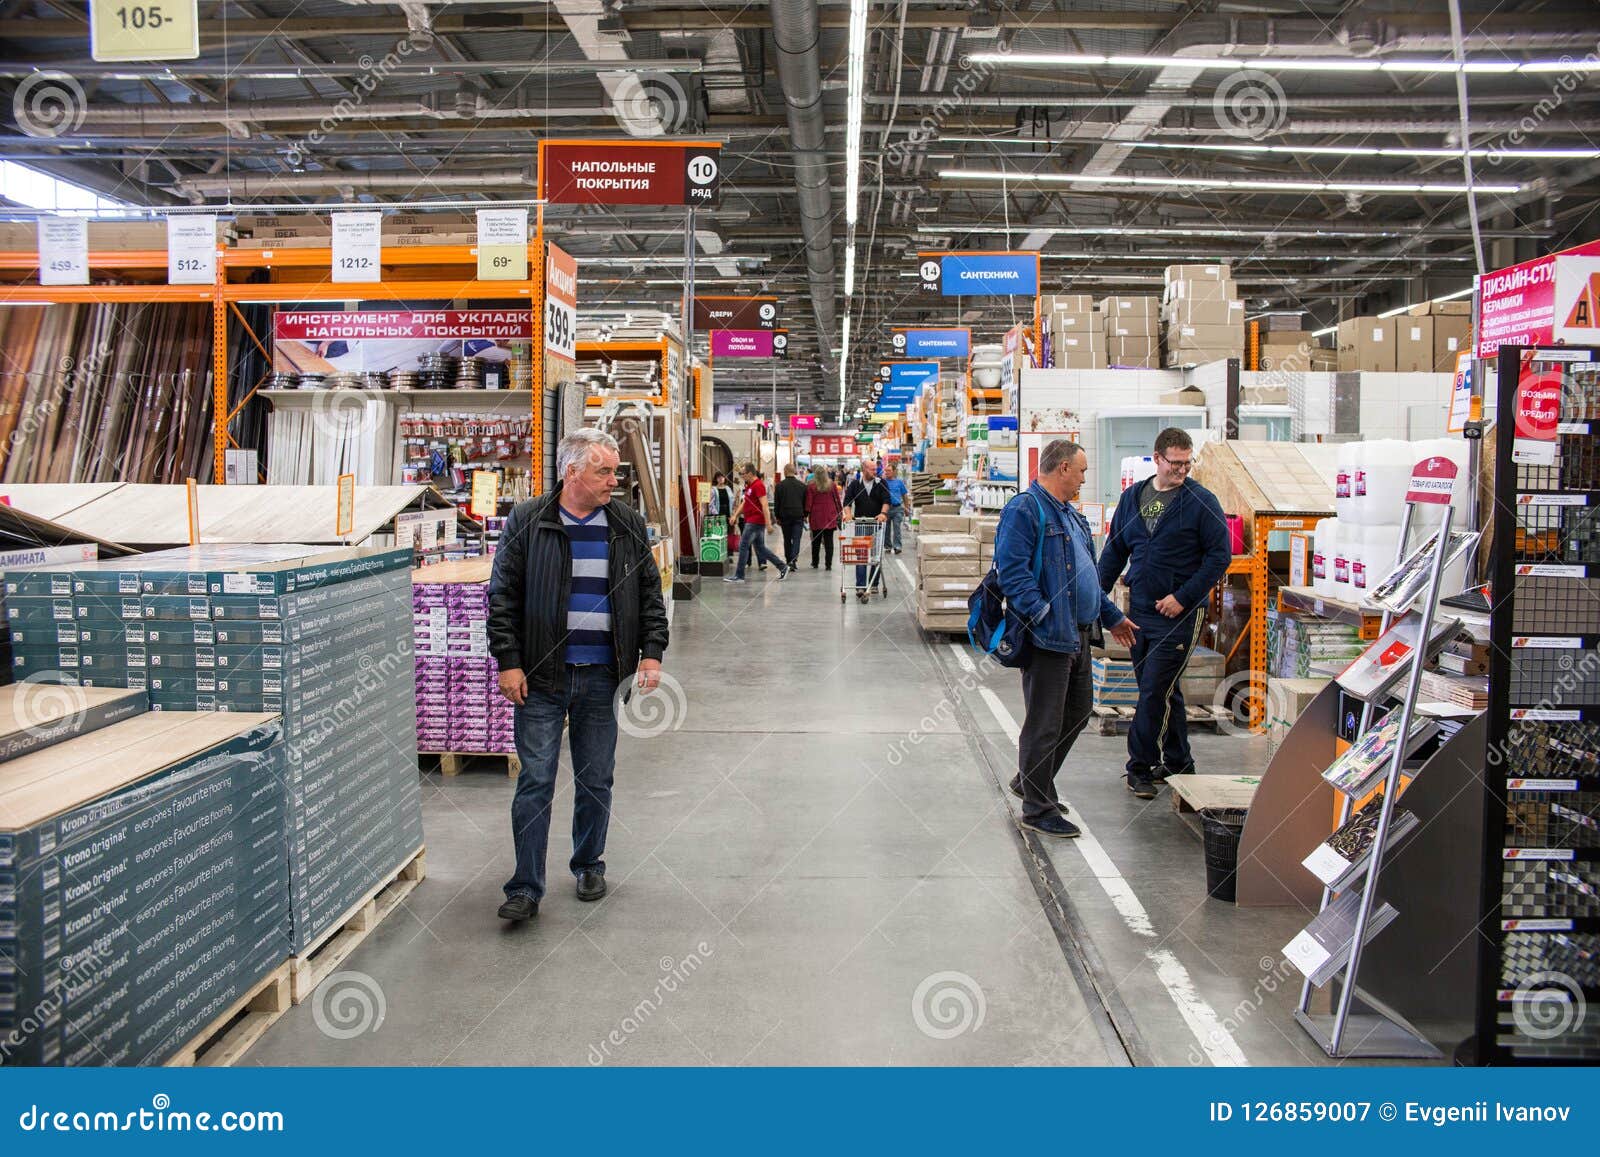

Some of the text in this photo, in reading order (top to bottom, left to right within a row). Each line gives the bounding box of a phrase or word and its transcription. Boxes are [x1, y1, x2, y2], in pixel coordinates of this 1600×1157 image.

[117, 6, 173, 29] 105-
[571, 161, 656, 173] НАПОЛЬНЫЕ
[691, 162, 713, 177] 10
[576, 178, 650, 190] ПОКРЫТИЯ
[691, 188, 712, 199] РЯД
[274, 230, 300, 238] IDEAL
[397, 237, 424, 245] IDEAL
[923, 266, 937, 276] 14
[960, 271, 1019, 280] САНТЕХНИКА
[923, 283, 937, 291] РЯД
[1483, 293, 1524, 314] КЕРАМИКИ
[709, 310, 733, 318] ДВЕРИ
[764, 307, 770, 316] 9
[285, 313, 399, 325] ИНСТРУМЕНТ
[411, 312, 446, 325] ДЛЯ
[306, 324, 522, 337] НАПОЛЬНЫХ ПОКРЫТИЙ
[1521, 390, 1557, 399] ВОЗЬМИ
[63, 847, 91, 869] Krono
[91, 830, 124, 854] Original
[172, 786, 209, 816] favourite
[209, 777, 232, 799] flooring
[64, 880, 92, 902] Krono
[92, 861, 126, 887] Original
[173, 815, 210, 846] favourite
[210, 803, 233, 826] flooring
[65, 913, 92, 936] Krono
[92, 892, 126, 919] Original
[173, 842, 210, 874] favourite
[210, 830, 233, 852] flooring
[174, 869, 210, 903] favourite
[211, 856, 234, 879] flooring
[175, 896, 211, 932] favourite
[211, 883, 235, 906] flooring
[175, 924, 212, 960] favourite
[212, 909, 235, 933] flooring
[175, 951, 212, 988] favourite
[212, 934, 235, 959] flooring
[176, 979, 212, 1016] favourite
[212, 960, 236, 986] flooring
[176, 985, 236, 1043] favourite flooring
